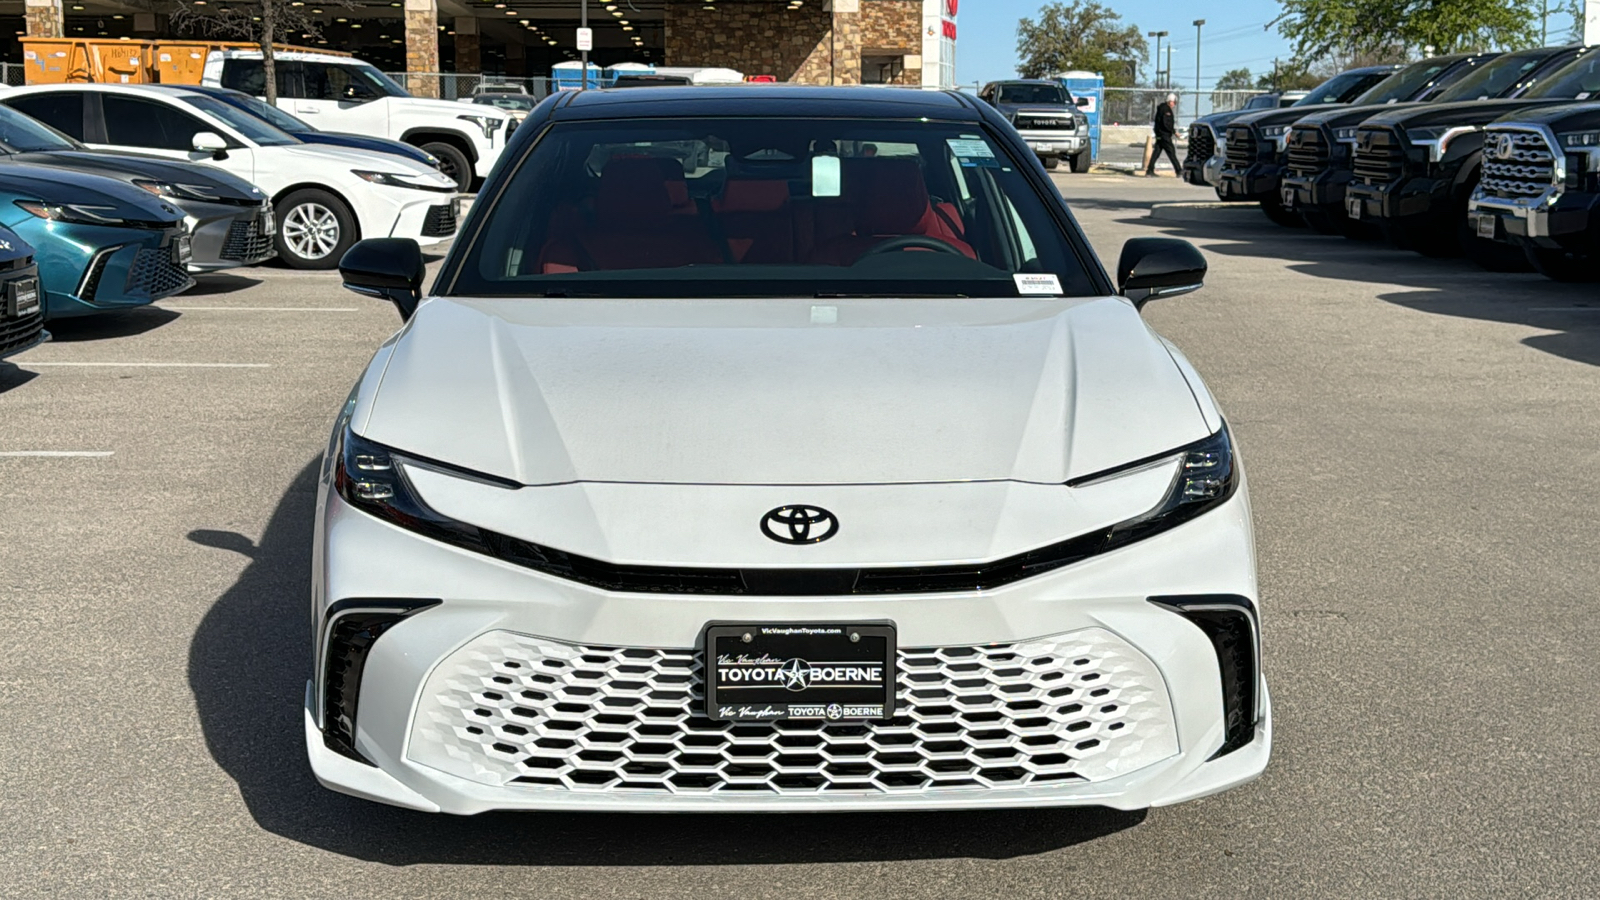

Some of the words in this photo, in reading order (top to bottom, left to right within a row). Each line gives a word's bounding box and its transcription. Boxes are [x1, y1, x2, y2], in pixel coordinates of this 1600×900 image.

[717, 654, 733, 664] Vic
[736, 653, 782, 666] Vaughan
[718, 668, 786, 681] TOYOTA
[809, 668, 882, 681] BOERNE
[719, 706, 736, 718] Vic
[738, 706, 785, 719] Vaughan
[788, 708, 826, 716] TOYOTA
[843, 708, 883, 716] BOERNE
